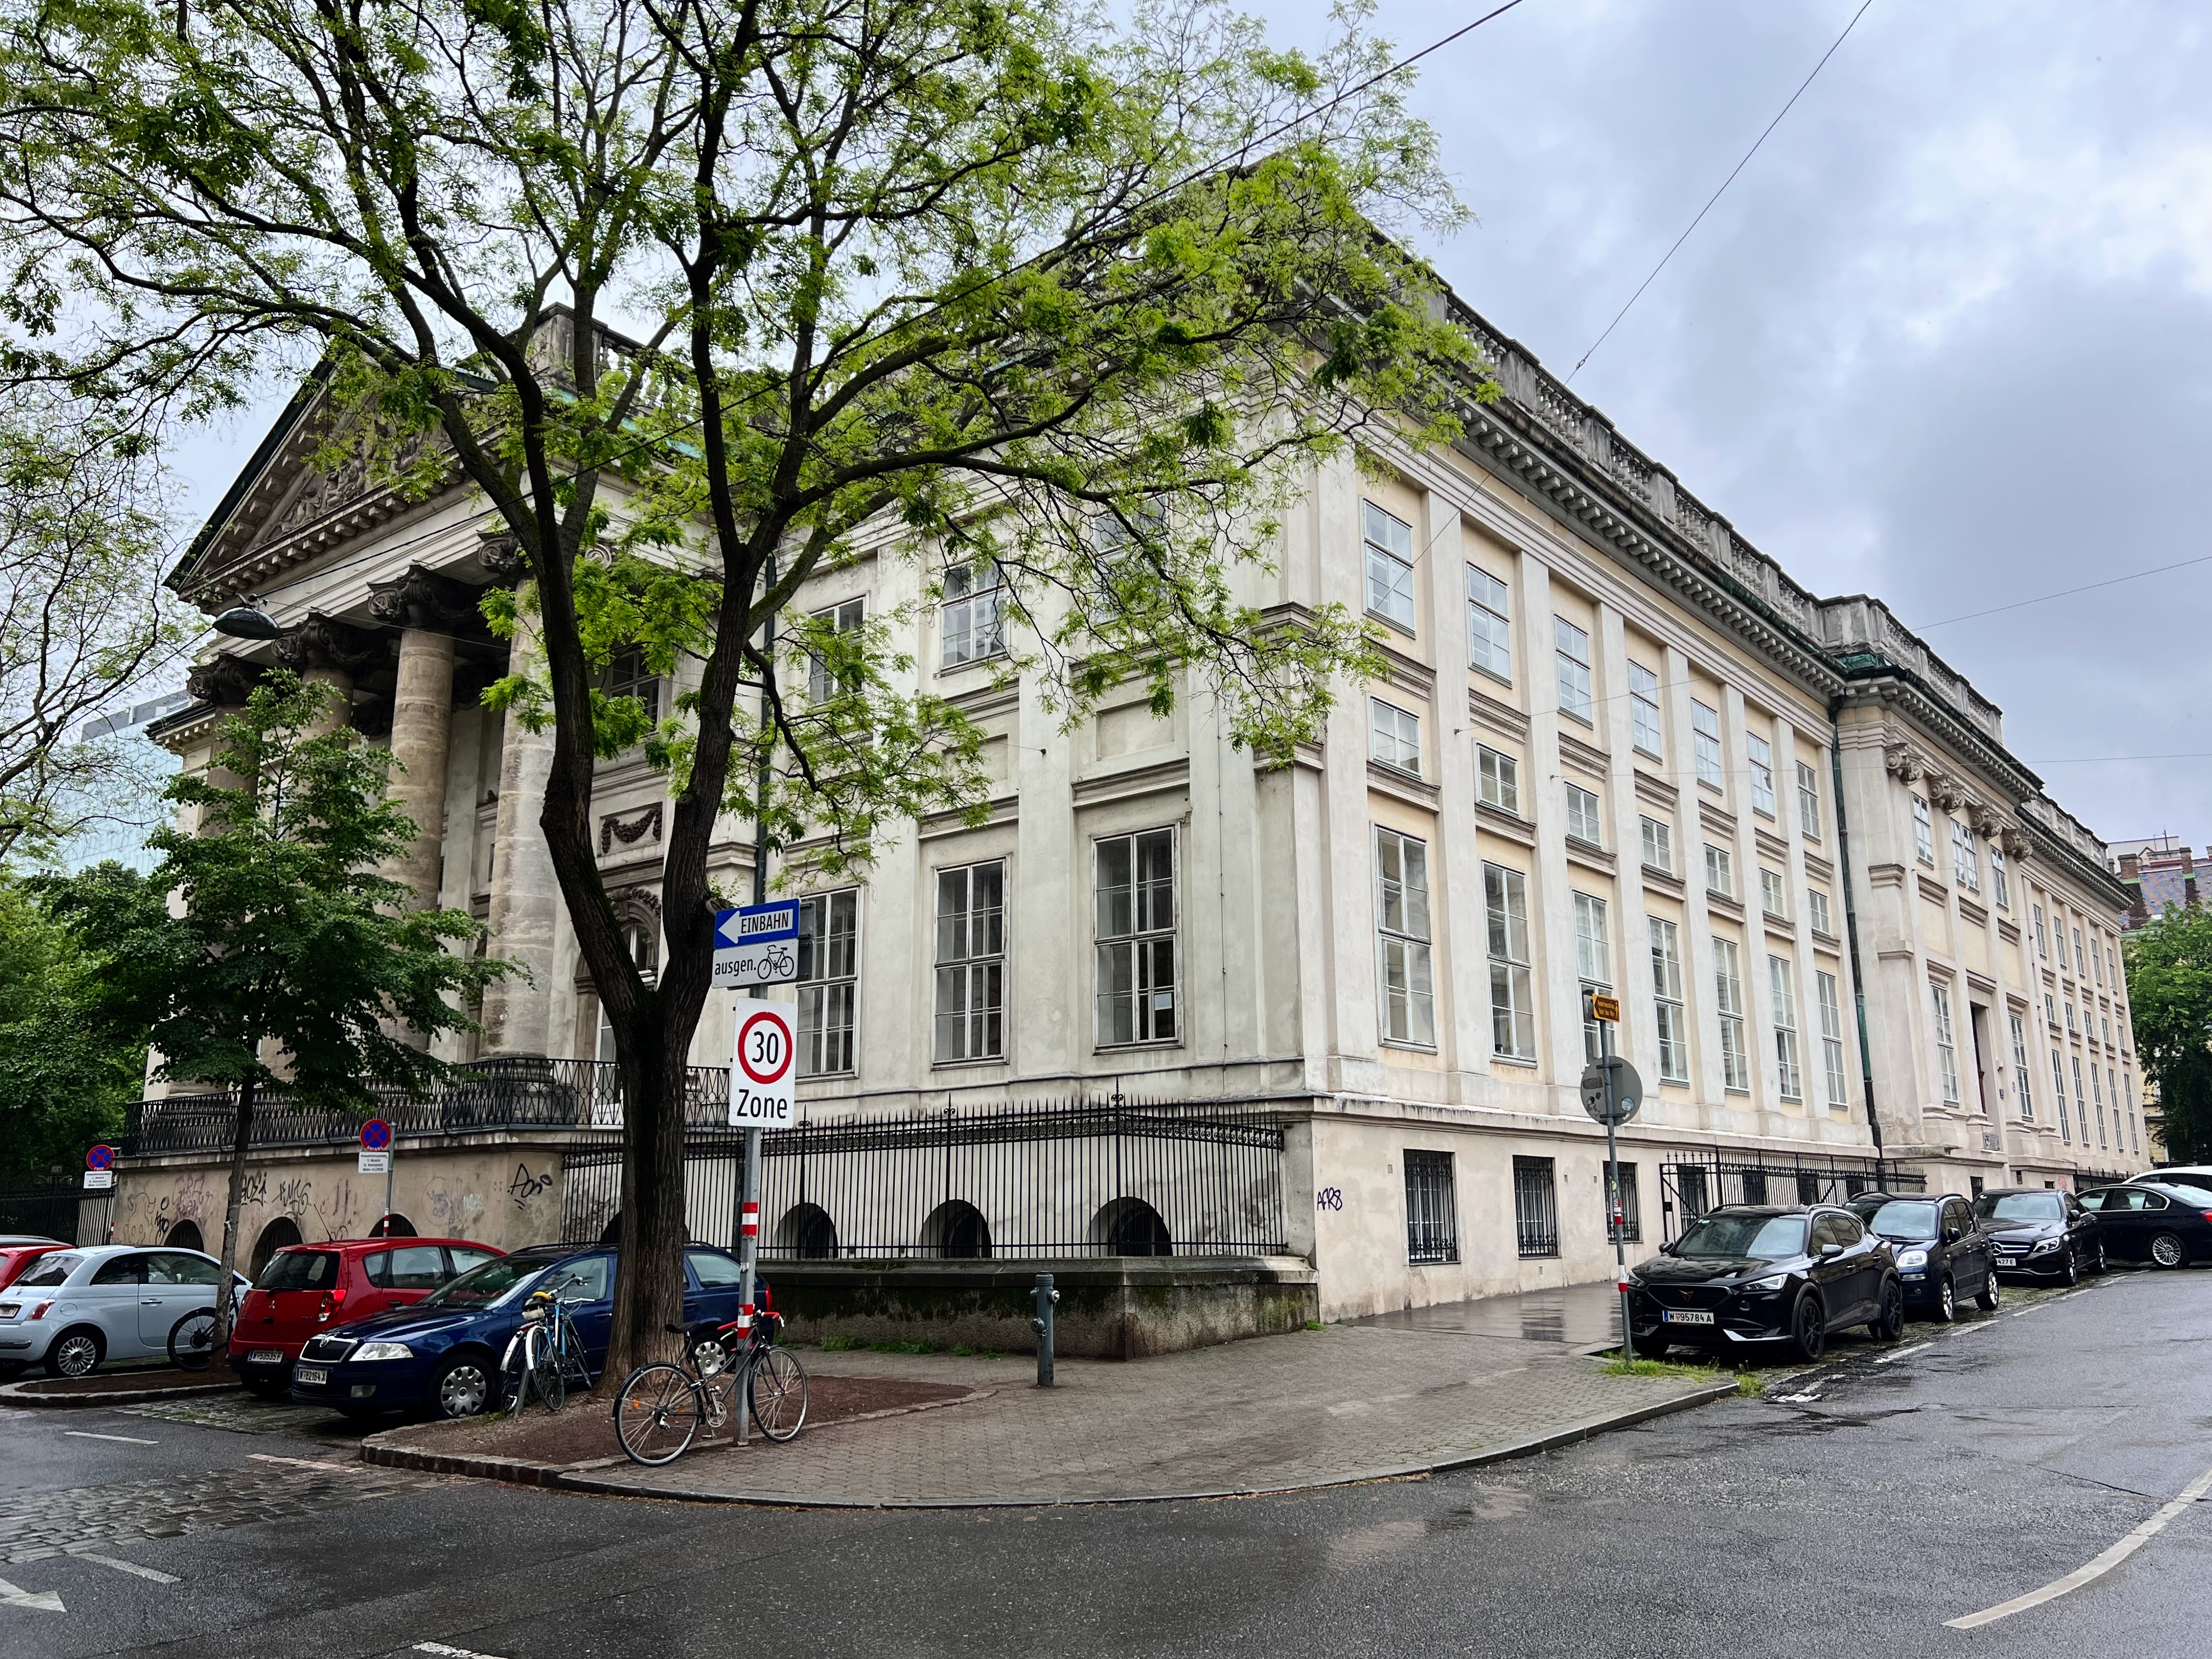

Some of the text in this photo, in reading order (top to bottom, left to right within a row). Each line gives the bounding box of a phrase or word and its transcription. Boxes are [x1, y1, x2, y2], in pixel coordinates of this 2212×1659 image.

[741, 912, 789, 934] EINBAHN
[715, 957, 757, 978] ausgen.
[752, 1031, 779, 1064] 30
[737, 1088, 788, 1119] Zone
[1680, 1313, 1705, 1322] 95784
[1706, 1314, 1712, 1323] A
